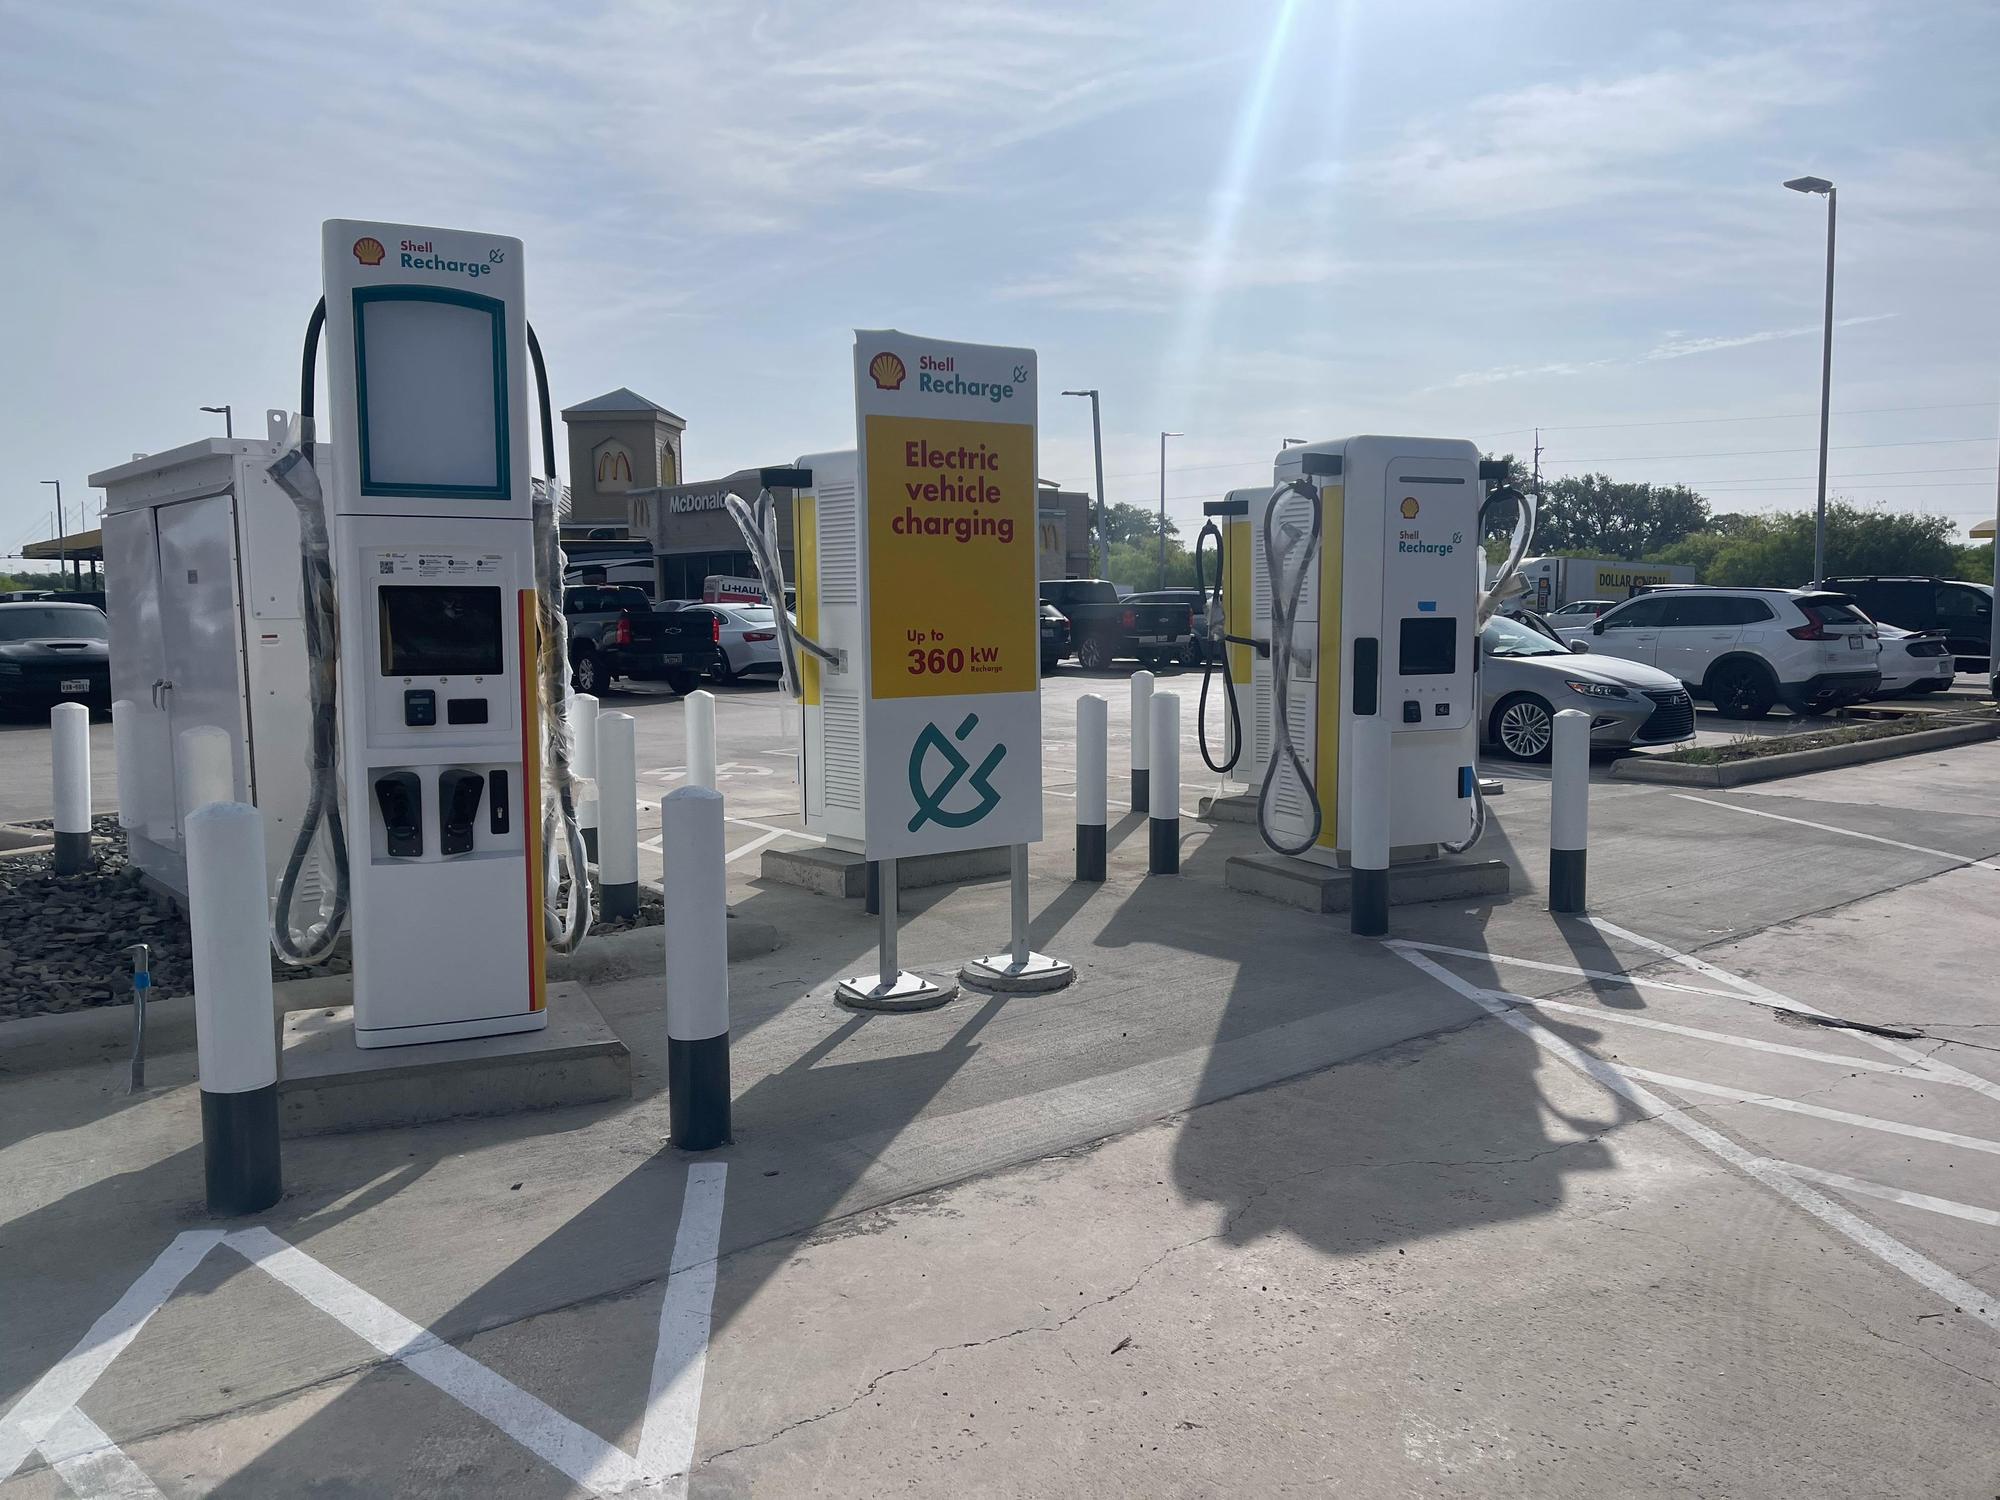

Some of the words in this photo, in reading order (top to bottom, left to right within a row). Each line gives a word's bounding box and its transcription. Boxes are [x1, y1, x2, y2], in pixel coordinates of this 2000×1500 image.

[400, 240, 433, 253] Shell
[400, 253, 491, 278] Recharge
[919, 356, 954, 372] Shell
[919, 372, 1014, 403] Recharge
[905, 440, 999, 471] Electric
[905, 475, 1001, 504] vehicle
[892, 507, 1014, 544] charging
[1399, 530, 1419, 540] Shell
[1398, 540, 1454, 557] Recharge
[721, 583, 763, 595] U-HAUL
[1599, 573, 1632, 588] DOLLAR
[1633, 575, 1667, 587] GNERAL
[907, 629, 926, 645] Up
[930, 629, 944, 641] to
[907, 647, 965, 675] 360
[970, 646, 999, 663] kW
